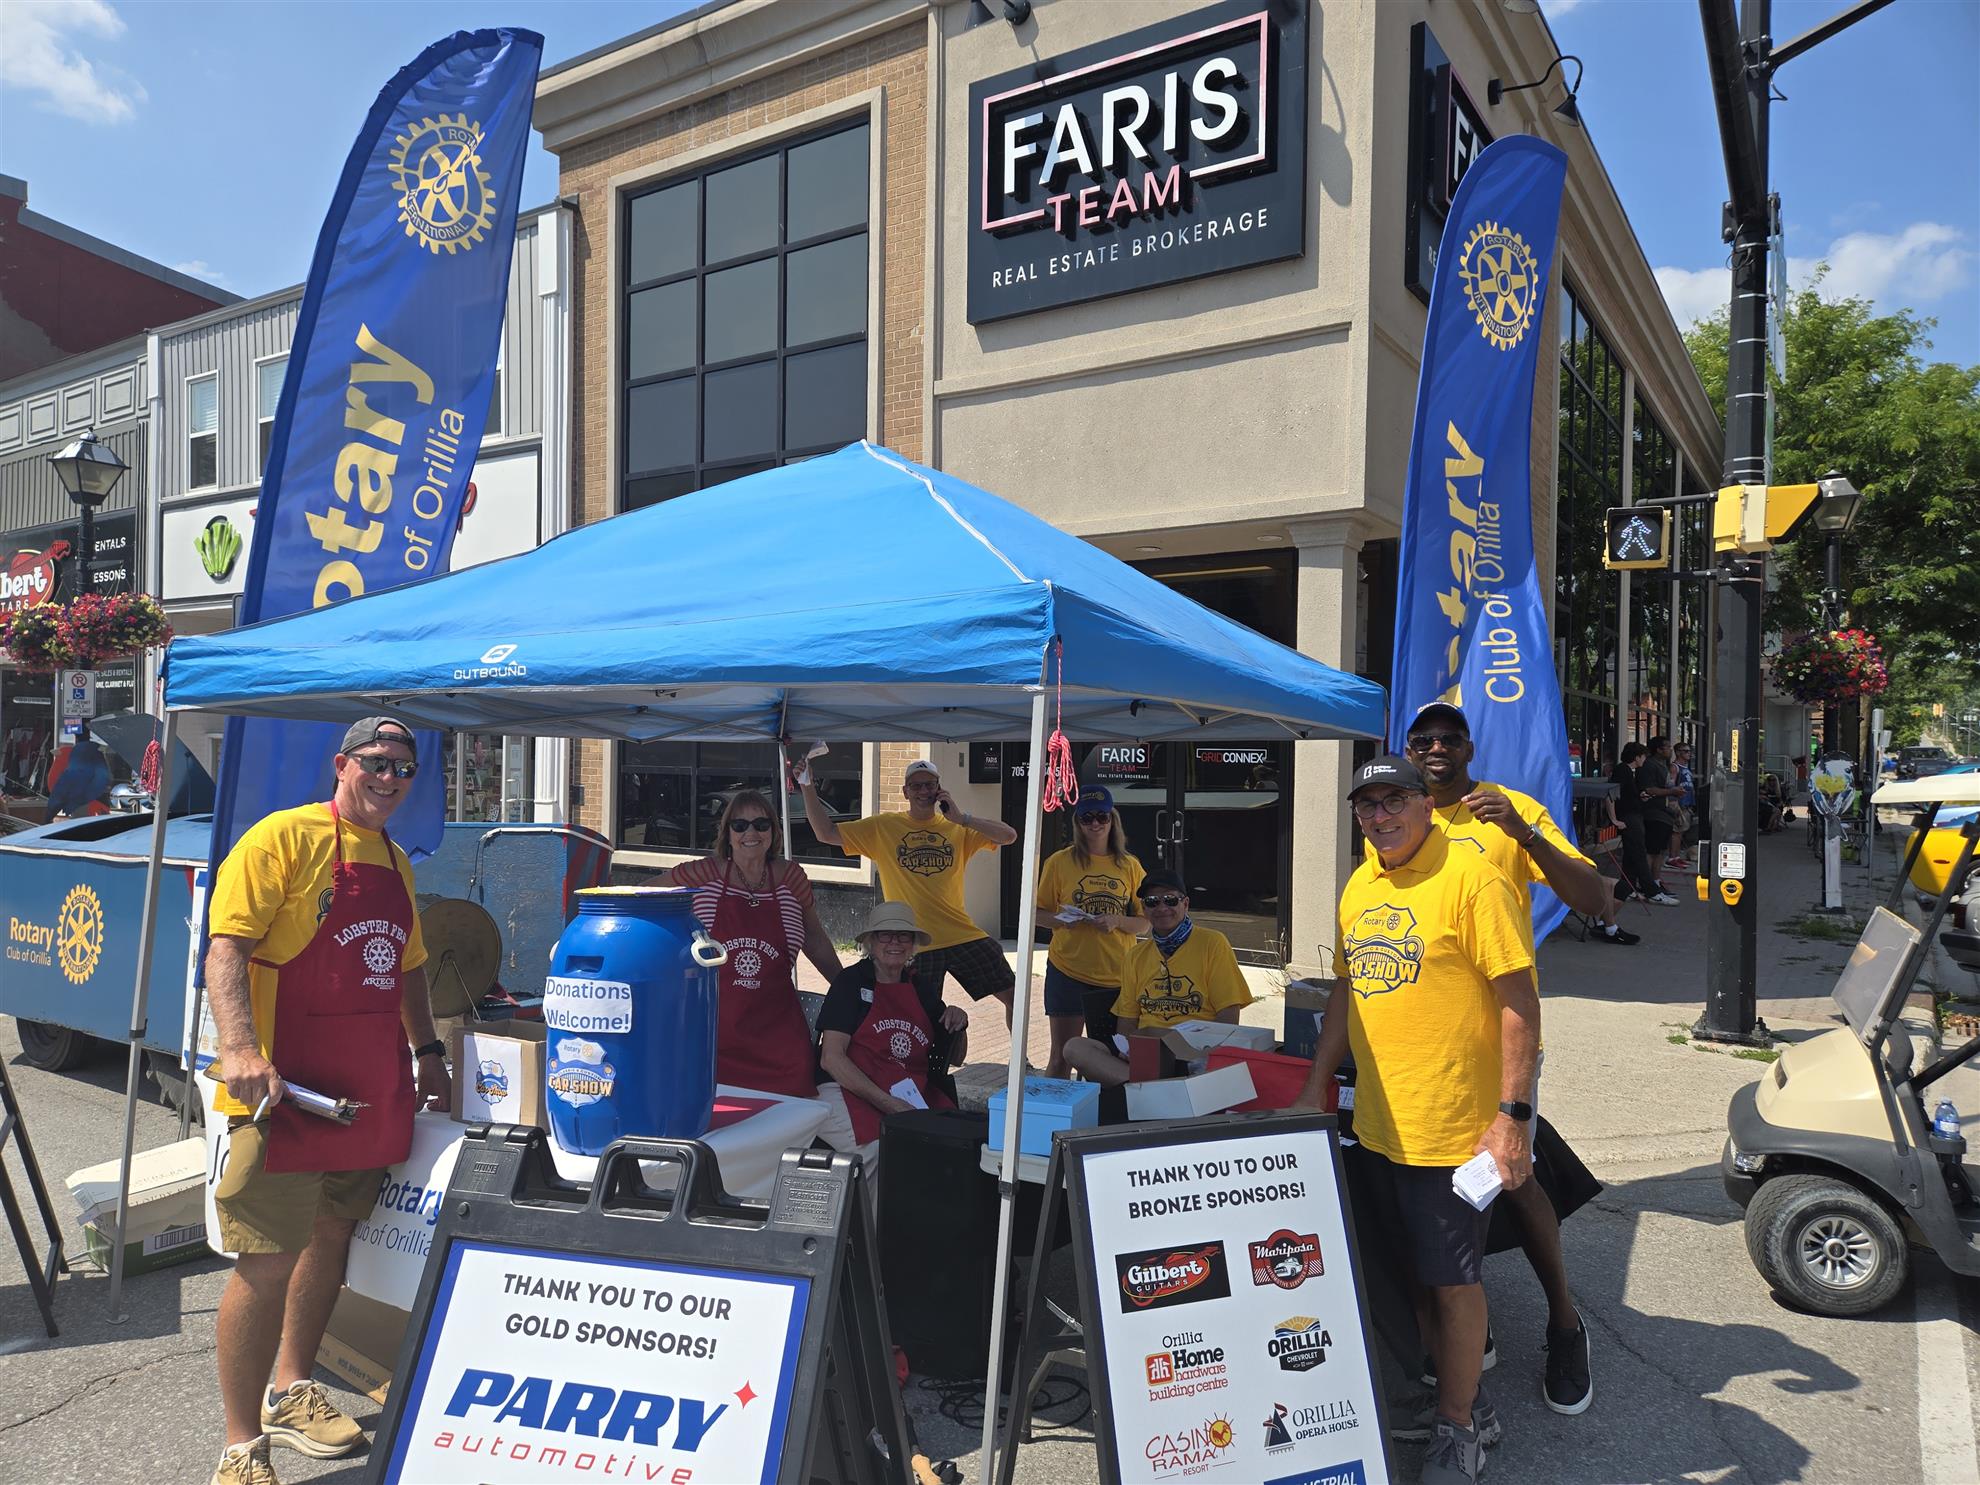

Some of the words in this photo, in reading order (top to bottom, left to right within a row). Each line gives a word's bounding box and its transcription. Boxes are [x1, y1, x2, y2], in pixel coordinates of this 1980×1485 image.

[1003, 57, 1239, 195] FARIS
[448, 128, 478, 151] ROTA
[1046, 164, 1180, 232] TEAM
[408, 188, 469, 239] INERNATIONAL
[992, 264, 1037, 288] REAL
[1050, 244, 1119, 275] ESTATE
[1132, 208, 1268, 257] BROKERAGE
[1487, 236, 1523, 257] ROTARY
[304, 322, 435, 609] otary
[412, 408, 465, 520] Orillia
[95, 537, 126, 551] ENTALS
[404, 526, 433, 571] of
[0, 567, 47, 599] bert
[93, 569, 126, 583] ESSONS
[1, 599, 29, 612] TARS
[1474, 591, 1512, 618] of
[454, 665, 527, 680] OUTBOUND
[1484, 628, 1525, 703] Club
[1101, 748, 1146, 763] FARIS
[1011, 766, 1025, 776] 705
[1110, 764, 1136, 772] TEAM
[1364, 917, 1386, 927] Rotary
[11, 917, 54, 952] Rotary
[333, 920, 389, 947] LOBSTER
[390, 924, 407, 945] FES
[6, 946, 21, 960] Club
[22, 949, 30, 961] of
[30, 951, 52, 966] Orillia
[720, 938, 757, 953] OBSTER
[759, 941, 779, 960] FEST
[362, 978, 395, 987] ARTECH
[1366, 961, 1418, 982] SHOW
[546, 978, 631, 1000] Donations
[546, 1008, 630, 1030] Welcome!
[873, 1019, 911, 1034] LOBSTER
[911, 1026, 929, 1047] FEST
[563, 1045, 581, 1053] Rotary
[548, 1075, 570, 1092] CAR
[573, 1079, 613, 1096] SHOW
[1127, 1165, 1190, 1188] THANK
[1193, 1160, 1230, 1179] YOU
[1234, 1157, 1258, 1174] TO
[1262, 1153, 1298, 1171] OUR
[379, 1172, 442, 1226] Rotary
[1128, 1194, 1202, 1219] BRONZE
[1206, 1181, 1307, 1209] SPONSORS!
[370, 1224, 386, 1246] of
[1254, 1243, 1315, 1259] Mariposa
[1128, 1259, 1203, 1285] Gilbert
[503, 1273, 580, 1302] THANK
[587, 1283, 636, 1310] YOU
[642, 1290, 674, 1312] TO
[679, 1294, 732, 1321] OUR
[1136, 1279, 1189, 1293] GUITARS
[505, 1313, 570, 1340] GOLD
[575, 1322, 718, 1360] SPONSORS!
[1162, 1332, 1203, 1348] Orillia
[1268, 1330, 1332, 1357] ORILLIA
[1172, 1347, 1225, 1369] Home
[1286, 1351, 1318, 1363] CHEVROLET
[1174, 1364, 1226, 1382] hardware
[1148, 1384, 1195, 1401] building
[1196, 1378, 1228, 1393] centre
[443, 1368, 729, 1453] PARRY
[1292, 1399, 1356, 1427] ORILLIA
[1296, 1425, 1328, 1440] OPERA
[1329, 1418, 1360, 1433] HOUSE
[434, 1431, 693, 1485] automotive
[1152, 1448, 1217, 1472] RAMA
[1183, 1464, 1210, 1477] RESORT
